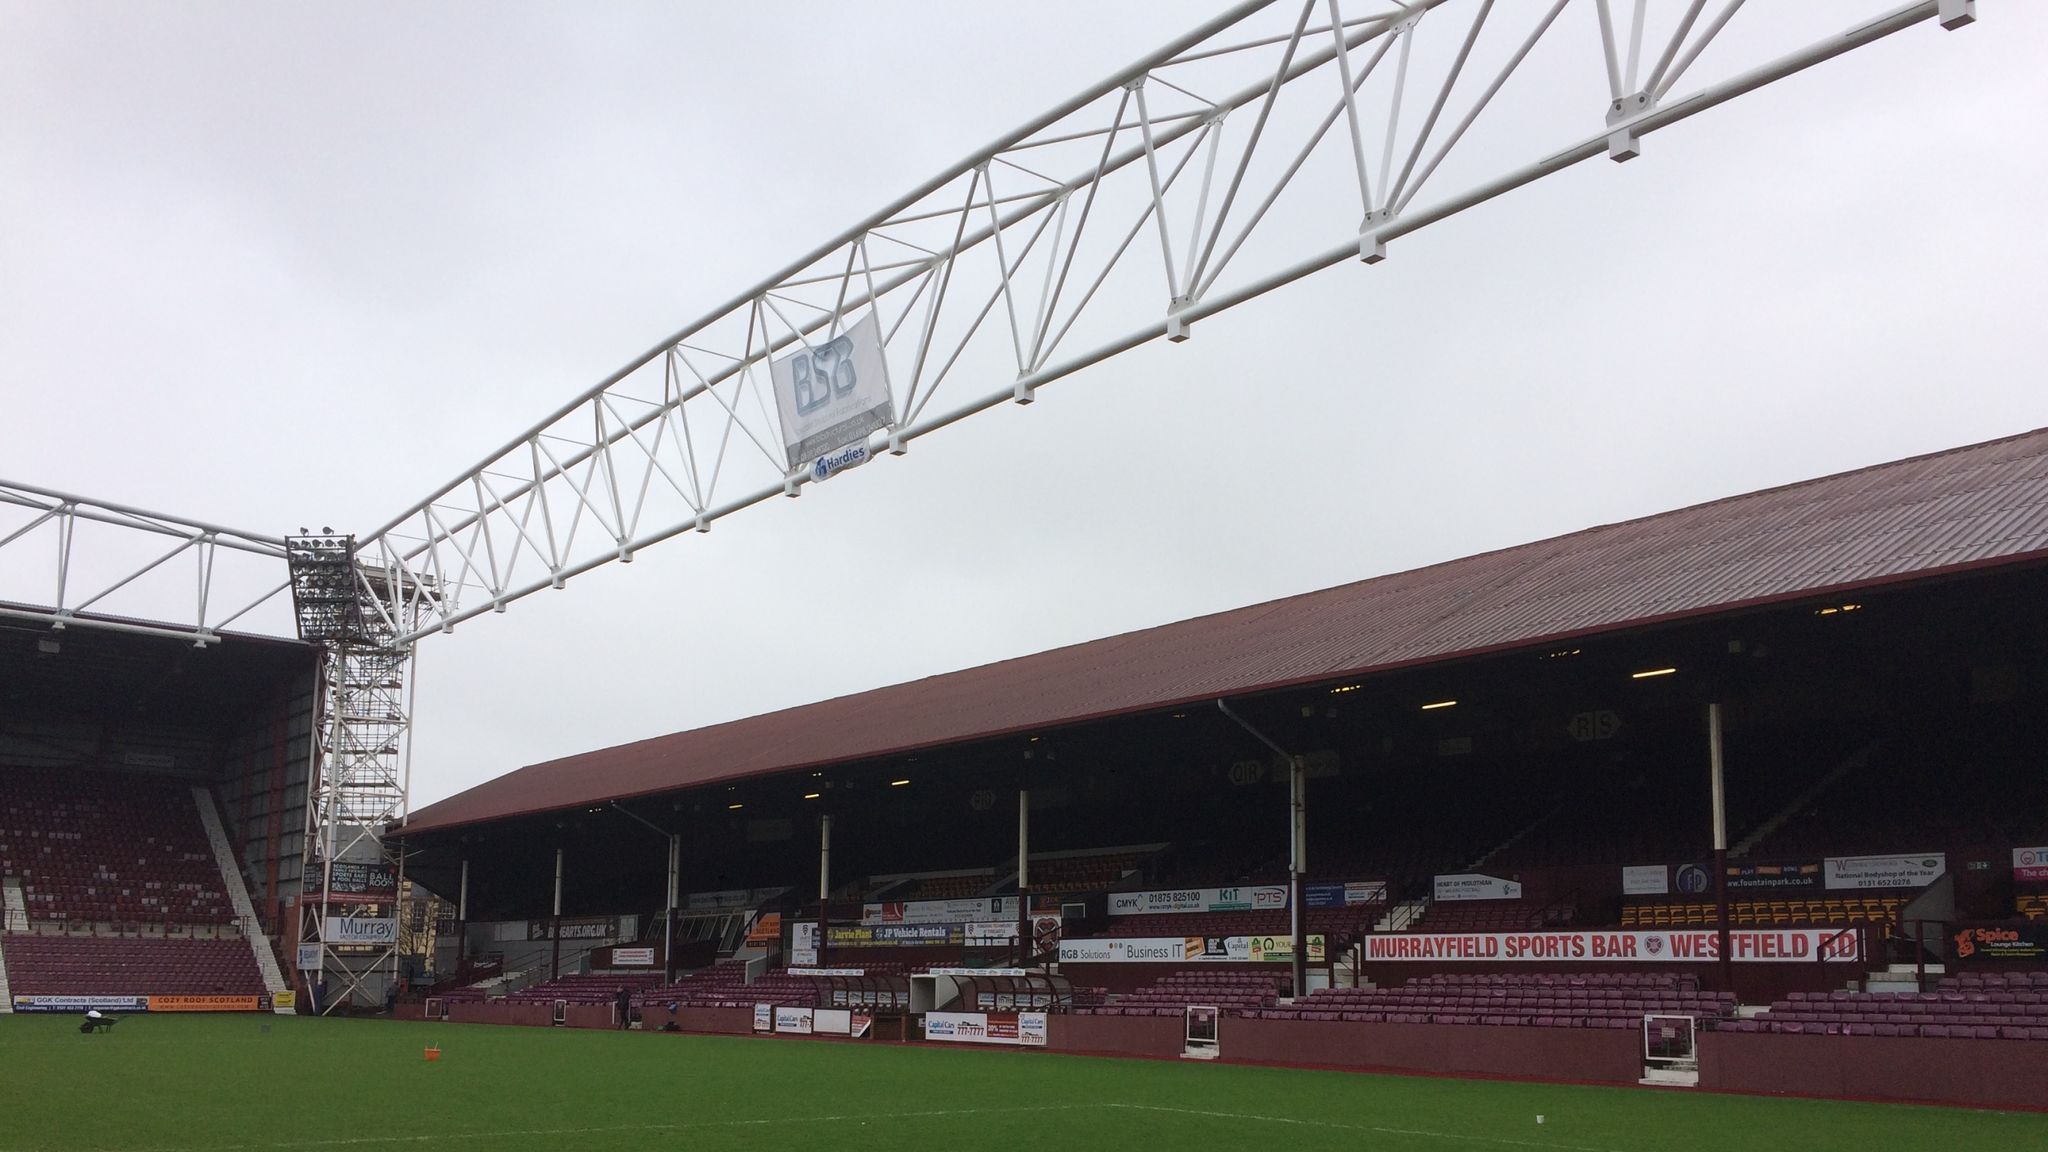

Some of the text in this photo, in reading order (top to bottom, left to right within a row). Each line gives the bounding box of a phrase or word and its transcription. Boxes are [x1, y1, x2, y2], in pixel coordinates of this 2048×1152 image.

[826, 446, 866, 470] Hardies
[369, 872, 394, 880] BALL
[1835, 871, 1863, 879] National
[1864, 870, 1898, 880] Bodyshop
[1919, 869, 1934, 877] Year
[2021, 868, 2037, 877] The
[1461, 879, 1493, 887] MIDLOTHIAN
[1727, 877, 1813, 889] ww.fountainpark.co.uk
[1858, 879, 1876, 887] 0131
[1877, 879, 1892, 887] 652
[1149, 891, 1201, 903] 01875 825100
[1256, 891, 1282, 904] PTS
[1116, 899, 1138, 909] CMYK
[340, 918, 394, 938] Murray
[854, 928, 873, 939] Plant
[883, 928, 893, 939] JP
[893, 927, 918, 938] Vehicle
[919, 926, 946, 938] Rentals
[1975, 928, 2019, 944] Spice
[1127, 944, 1169, 959] Business
[1172, 943, 1184, 958] IT
[1370, 933, 1856, 958] MURRAYFIELD SPORTS BAR WESTFIELD RD
[1061, 949, 1111, 959] RGB Solutions
[54, 996, 87, 1004] Contracts
[88, 996, 122, 1005] (Scotland)
[123, 996, 134, 1004] Ltd
[928, 1019, 955, 1029] Capital Cars
[1021, 1017, 1035, 1026] Capital
[957, 1026, 984, 1036] 777-7777
